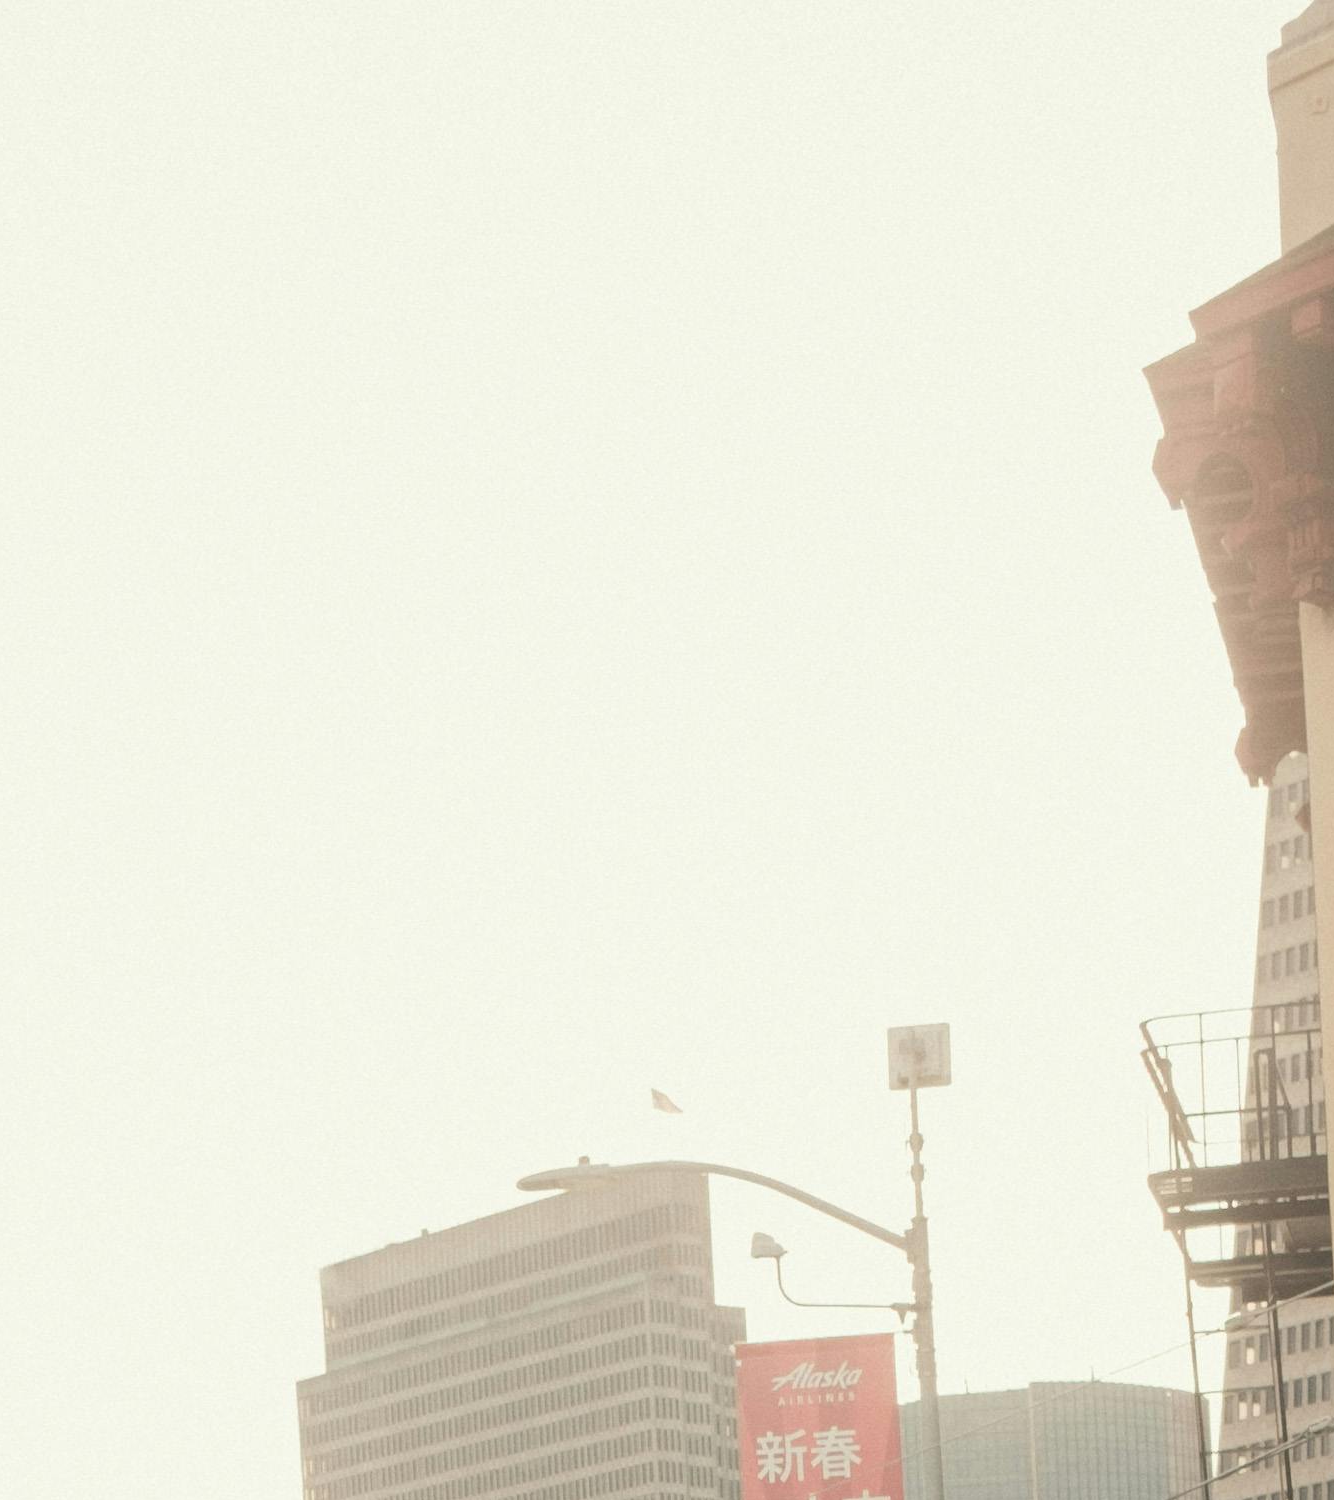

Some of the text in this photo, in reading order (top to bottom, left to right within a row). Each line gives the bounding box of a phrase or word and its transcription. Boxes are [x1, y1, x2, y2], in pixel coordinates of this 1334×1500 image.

[771, 1360, 862, 1391] Alaska
[778, 1393, 856, 1407] AIRLINES
[756, 1425, 862, 1483] 新春
